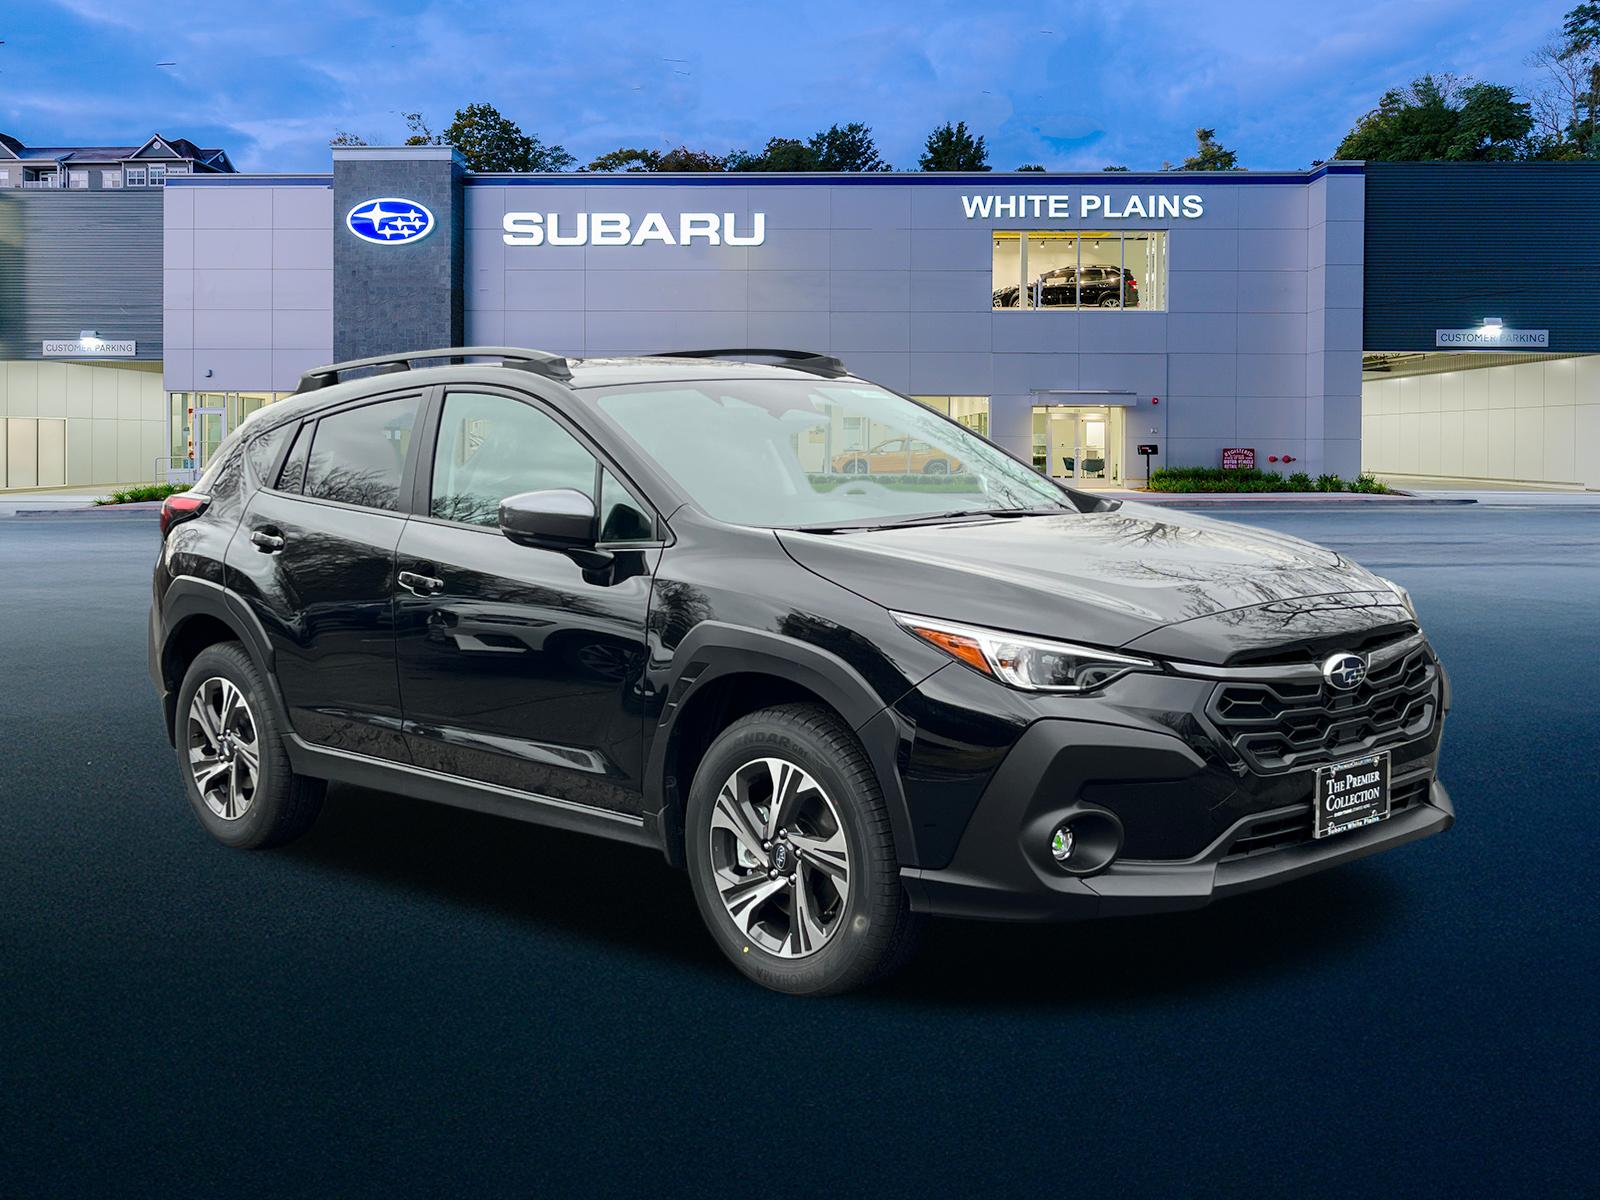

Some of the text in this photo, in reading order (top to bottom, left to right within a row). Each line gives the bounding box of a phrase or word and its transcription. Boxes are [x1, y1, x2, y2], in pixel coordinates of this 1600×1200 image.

[961, 194, 1205, 219] WHITE PLAINS
[502, 212, 766, 247] SUBARU
[46, 344, 133, 352] CUSTOMER PARKING
[1440, 333, 1545, 342] CUSTOMER PARKING
[1326, 771, 1380, 795] THE PREMIER
[1326, 786, 1380, 812] COLLECTION
